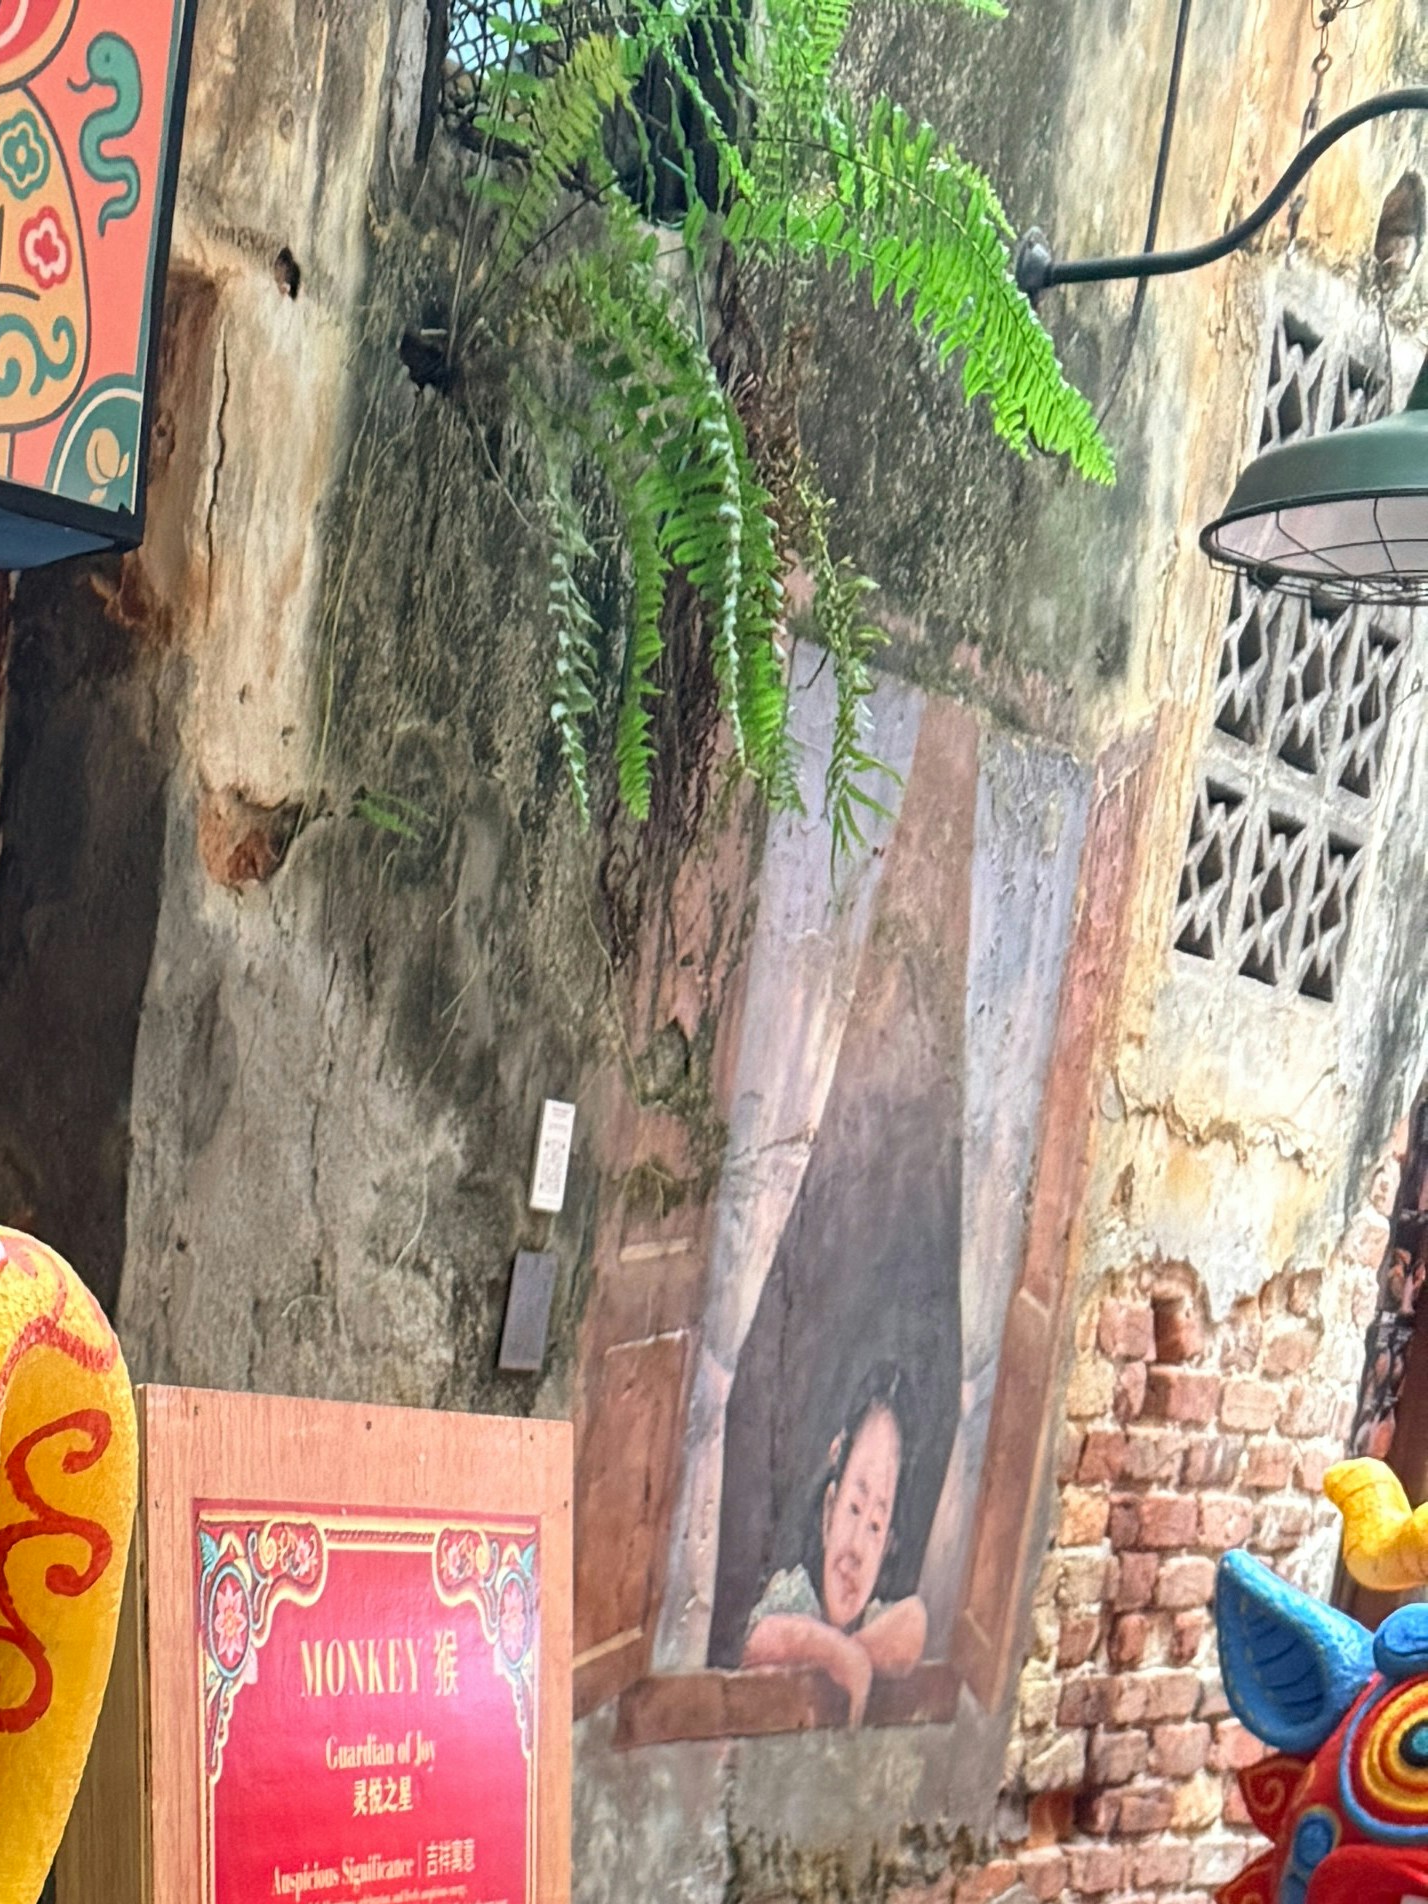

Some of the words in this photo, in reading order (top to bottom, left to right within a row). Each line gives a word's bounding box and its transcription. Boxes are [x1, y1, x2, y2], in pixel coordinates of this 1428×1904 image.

[300, 1636, 424, 1698] MONKEY
[433, 1630, 459, 1697] 猴
[325, 1732, 394, 1769] Guardian
[397, 1730, 413, 1765] of
[414, 1729, 436, 1773] Joy
[352, 1775, 414, 1817] 灵悦之星
[271, 1861, 339, 1903] Auspicious
[341, 1853, 414, 1894] Significance
